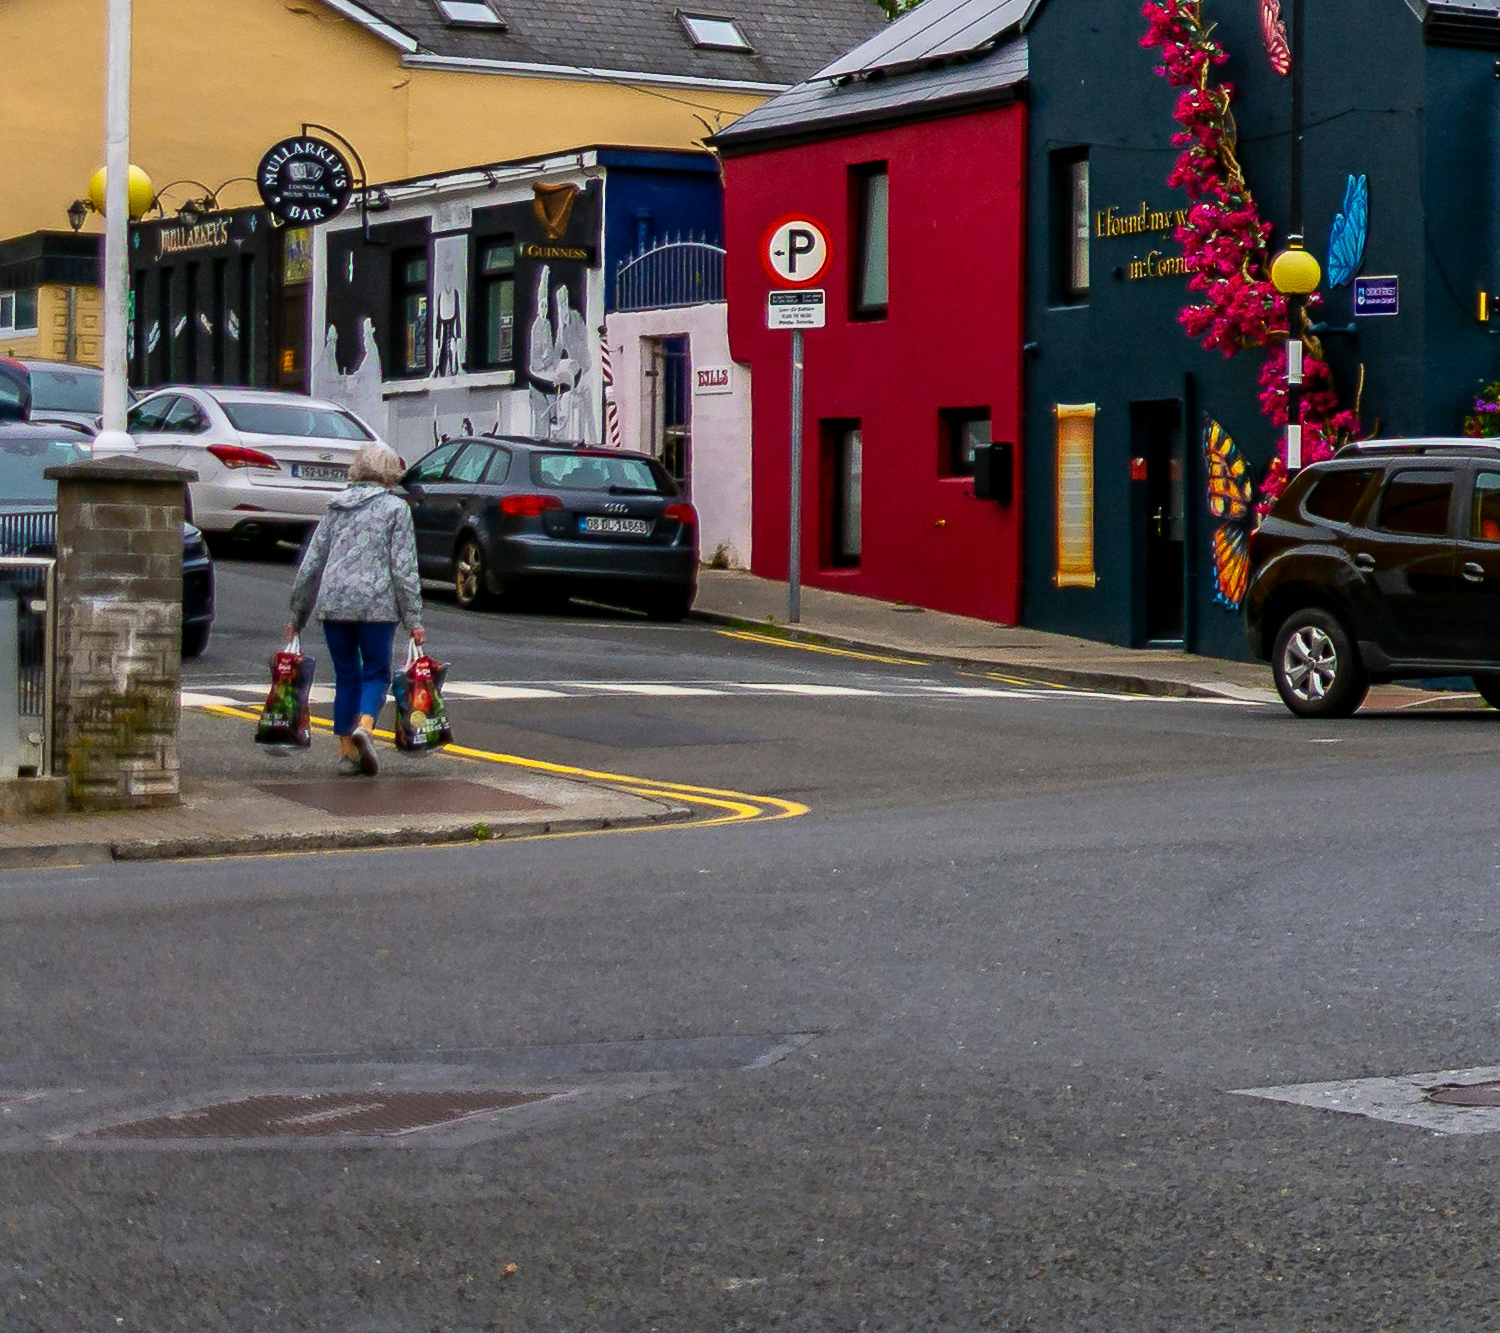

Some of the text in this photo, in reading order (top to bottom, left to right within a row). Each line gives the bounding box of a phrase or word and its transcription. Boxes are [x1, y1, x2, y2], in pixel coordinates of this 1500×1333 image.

[264, 142, 347, 189] MULLARKEY'S
[289, 205, 325, 221] BAR
[1107, 201, 1148, 236] found
[1149, 212, 1173, 239] my
[527, 244, 588, 259] GUINNESS
[1129, 260, 1146, 279] in
